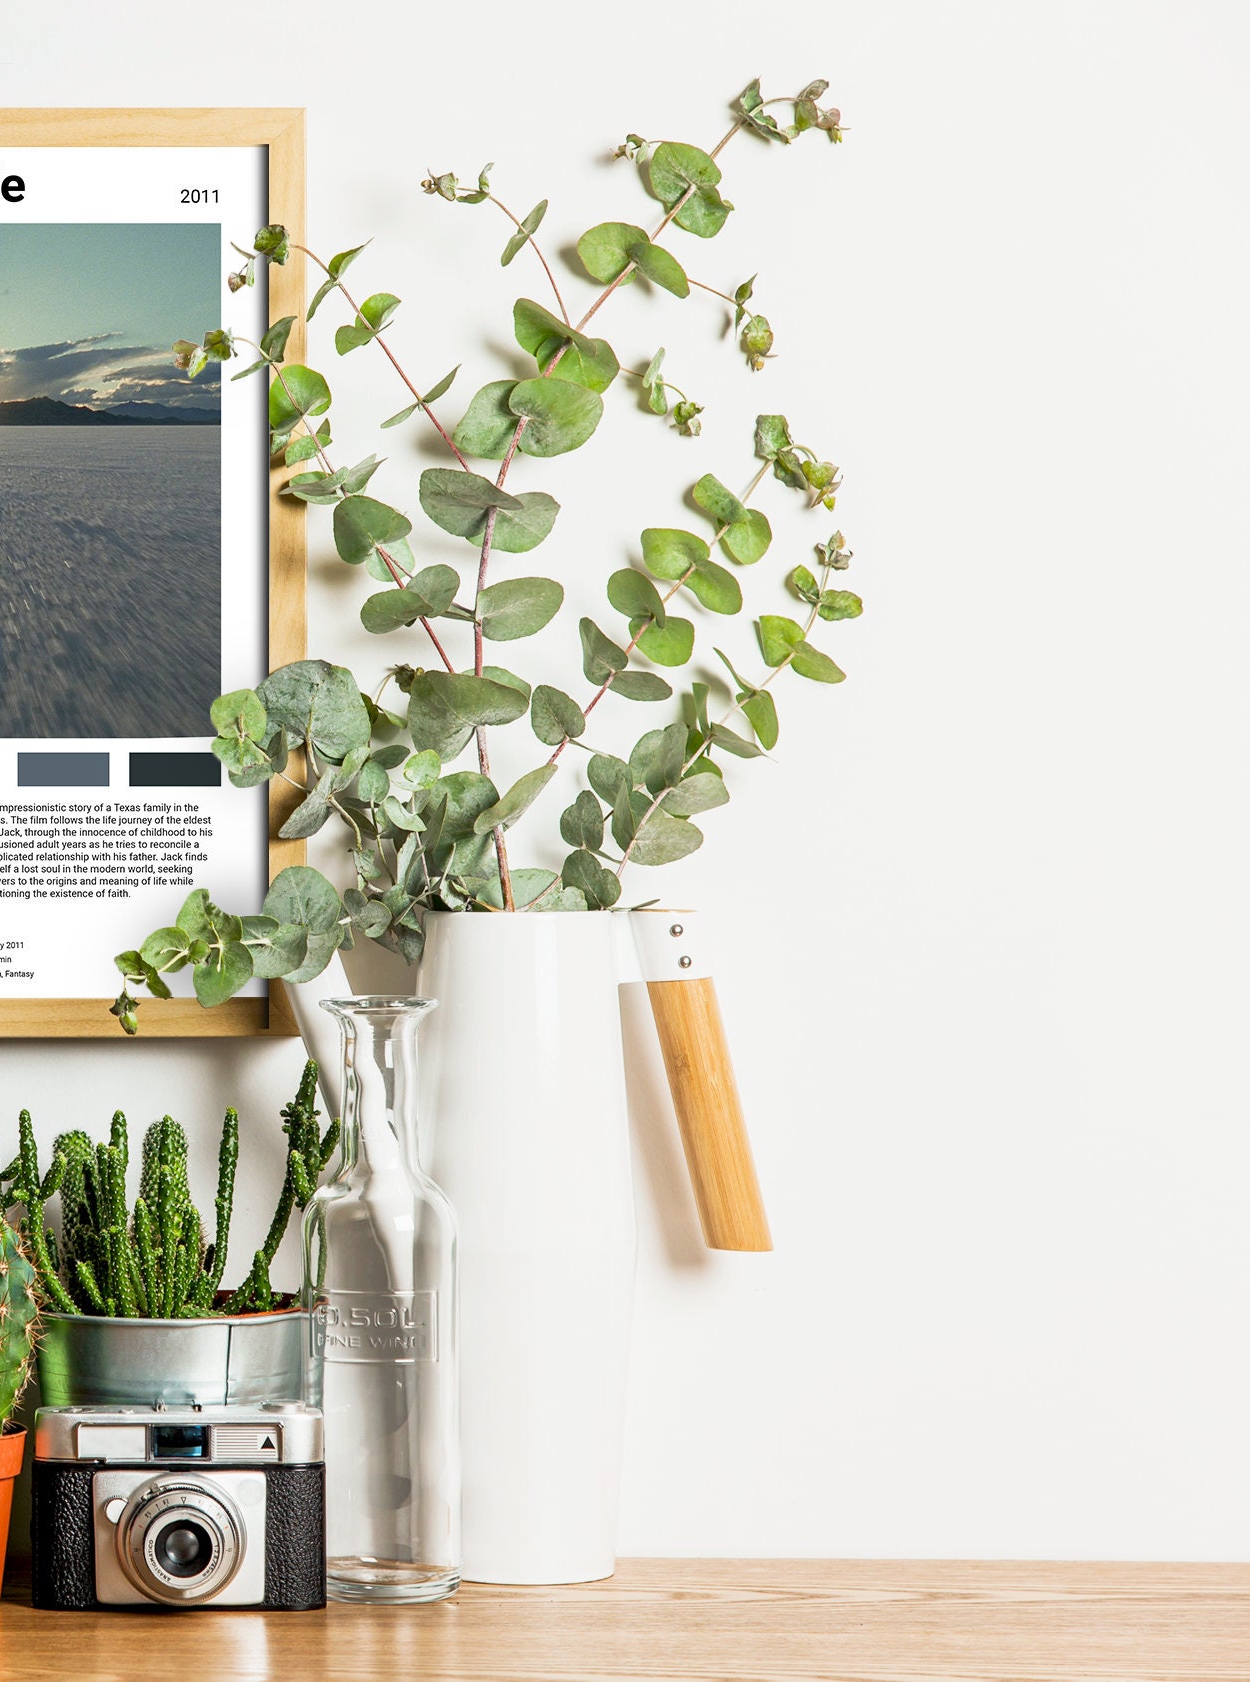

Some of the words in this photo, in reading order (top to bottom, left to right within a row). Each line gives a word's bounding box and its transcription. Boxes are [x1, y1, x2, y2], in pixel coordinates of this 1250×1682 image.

[181, 189, 218, 203] 2011
[69, 804, 92, 814] story
[94, 803, 103, 812] of
[114, 803, 140, 812] Texas
[143, 803, 171, 814] family
[174, 803, 181, 811] in
[184, 803, 199, 812] the
[10, 816, 27, 824] The
[30, 816, 47, 824] film
[50, 816, 83, 824] follows
[86, 816, 100, 824] the
[103, 816, 116, 824] life
[118, 816, 152, 826] journey
[155, 816, 164, 824] of
[166, 816, 181, 824] the
[183, 816, 211, 824] eldest
[24, 828, 60, 838] through
[62, 828, 77, 836] the
[80, 828, 126, 836] innocence
[128, 828, 138, 836] of
[140, 828, 185, 836] childhood
[200, 828, 213, 836] his
[37, 840, 59, 848] adult
[62, 842, 86, 850] years
[103, 840, 113, 848] he
[116, 840, 136, 848] tries
[150, 840, 191, 848] reconcile
[36, 852, 89, 863] relationship
[92, 852, 111, 861] with
[113, 852, 126, 861] his
[129, 852, 158, 861] father.
[161, 853, 182, 861] Jack
[185, 852, 208, 861] finds
[22, 865, 38, 873] lost
[41, 865, 60, 873] soul
[63, 865, 71, 873] in
[73, 865, 88, 873] the
[90, 865, 125, 873] modern
[128, 865, 155, 874] world,
[158, 865, 192, 875] seeking
[18, 877, 27, 885] to
[29, 877, 44, 885] the
[46, 877, 77, 887] origins
[80, 877, 96, 885] and
[100, 877, 138, 887] meaning
[141, 877, 151, 885] of
[154, 877, 167, 885] life
[169, 877, 193, 885] while
[33, 889, 47, 898] the
[50, 889, 93, 898] existence
[96, 889, 105, 897] of
[108, 889, 130, 898] faith.
[5, 970, 34, 979] Fantasy
